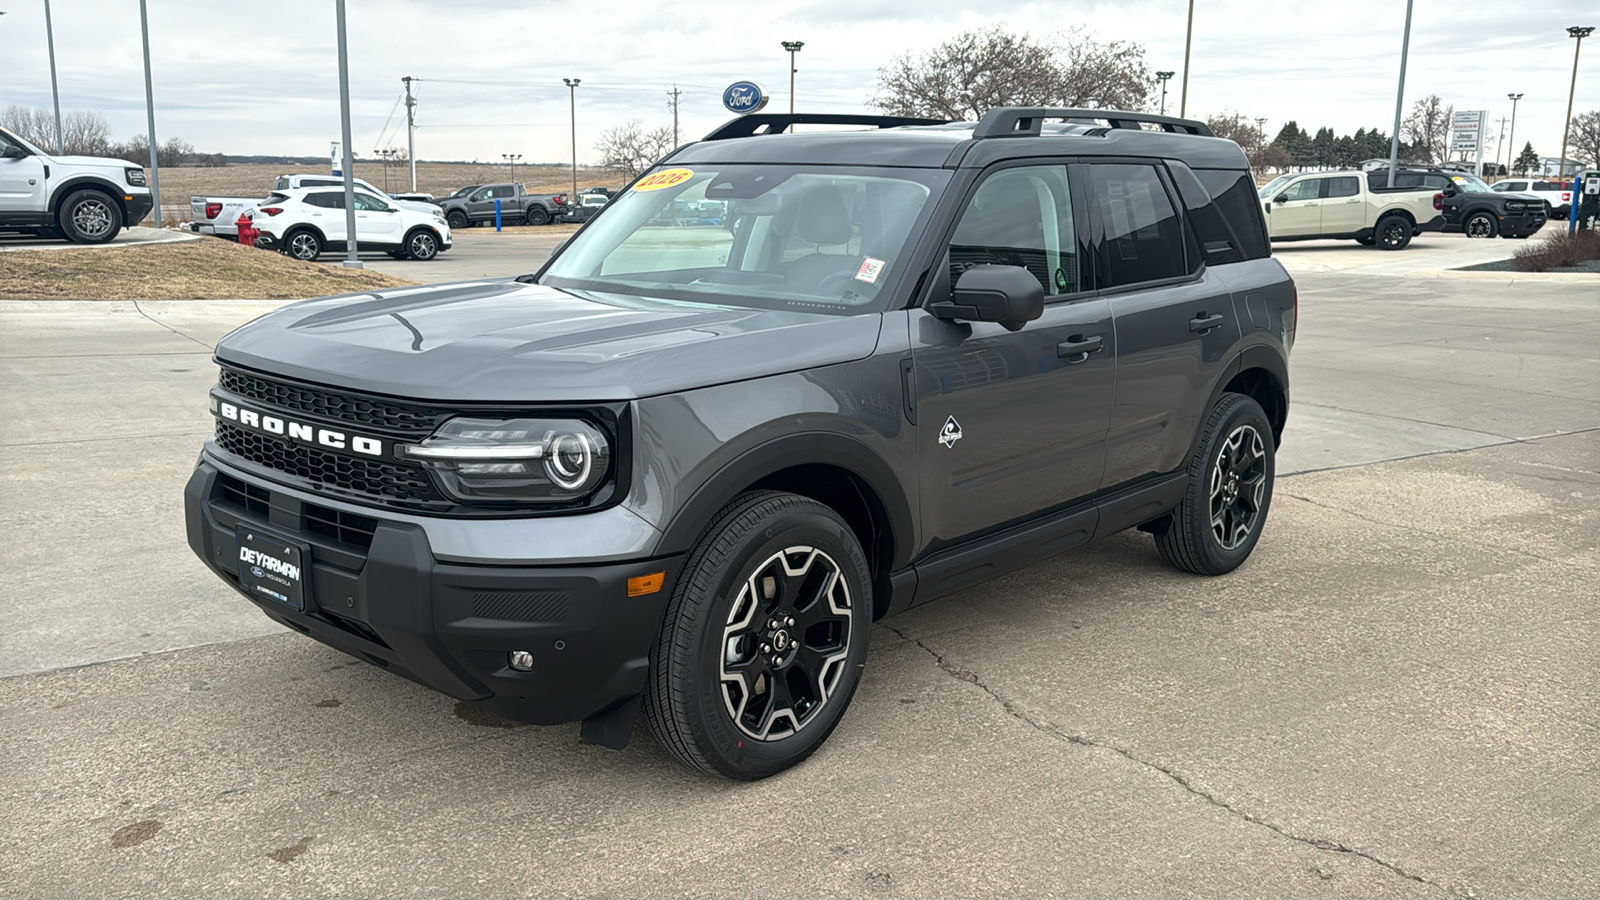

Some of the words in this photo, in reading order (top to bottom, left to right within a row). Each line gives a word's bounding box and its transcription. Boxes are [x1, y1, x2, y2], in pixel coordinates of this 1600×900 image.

[729, 87, 754, 107] Ford
[636, 172, 689, 188] 2026
[220, 402, 382, 456] BRONCO
[240, 546, 300, 581] DEYARMAN
